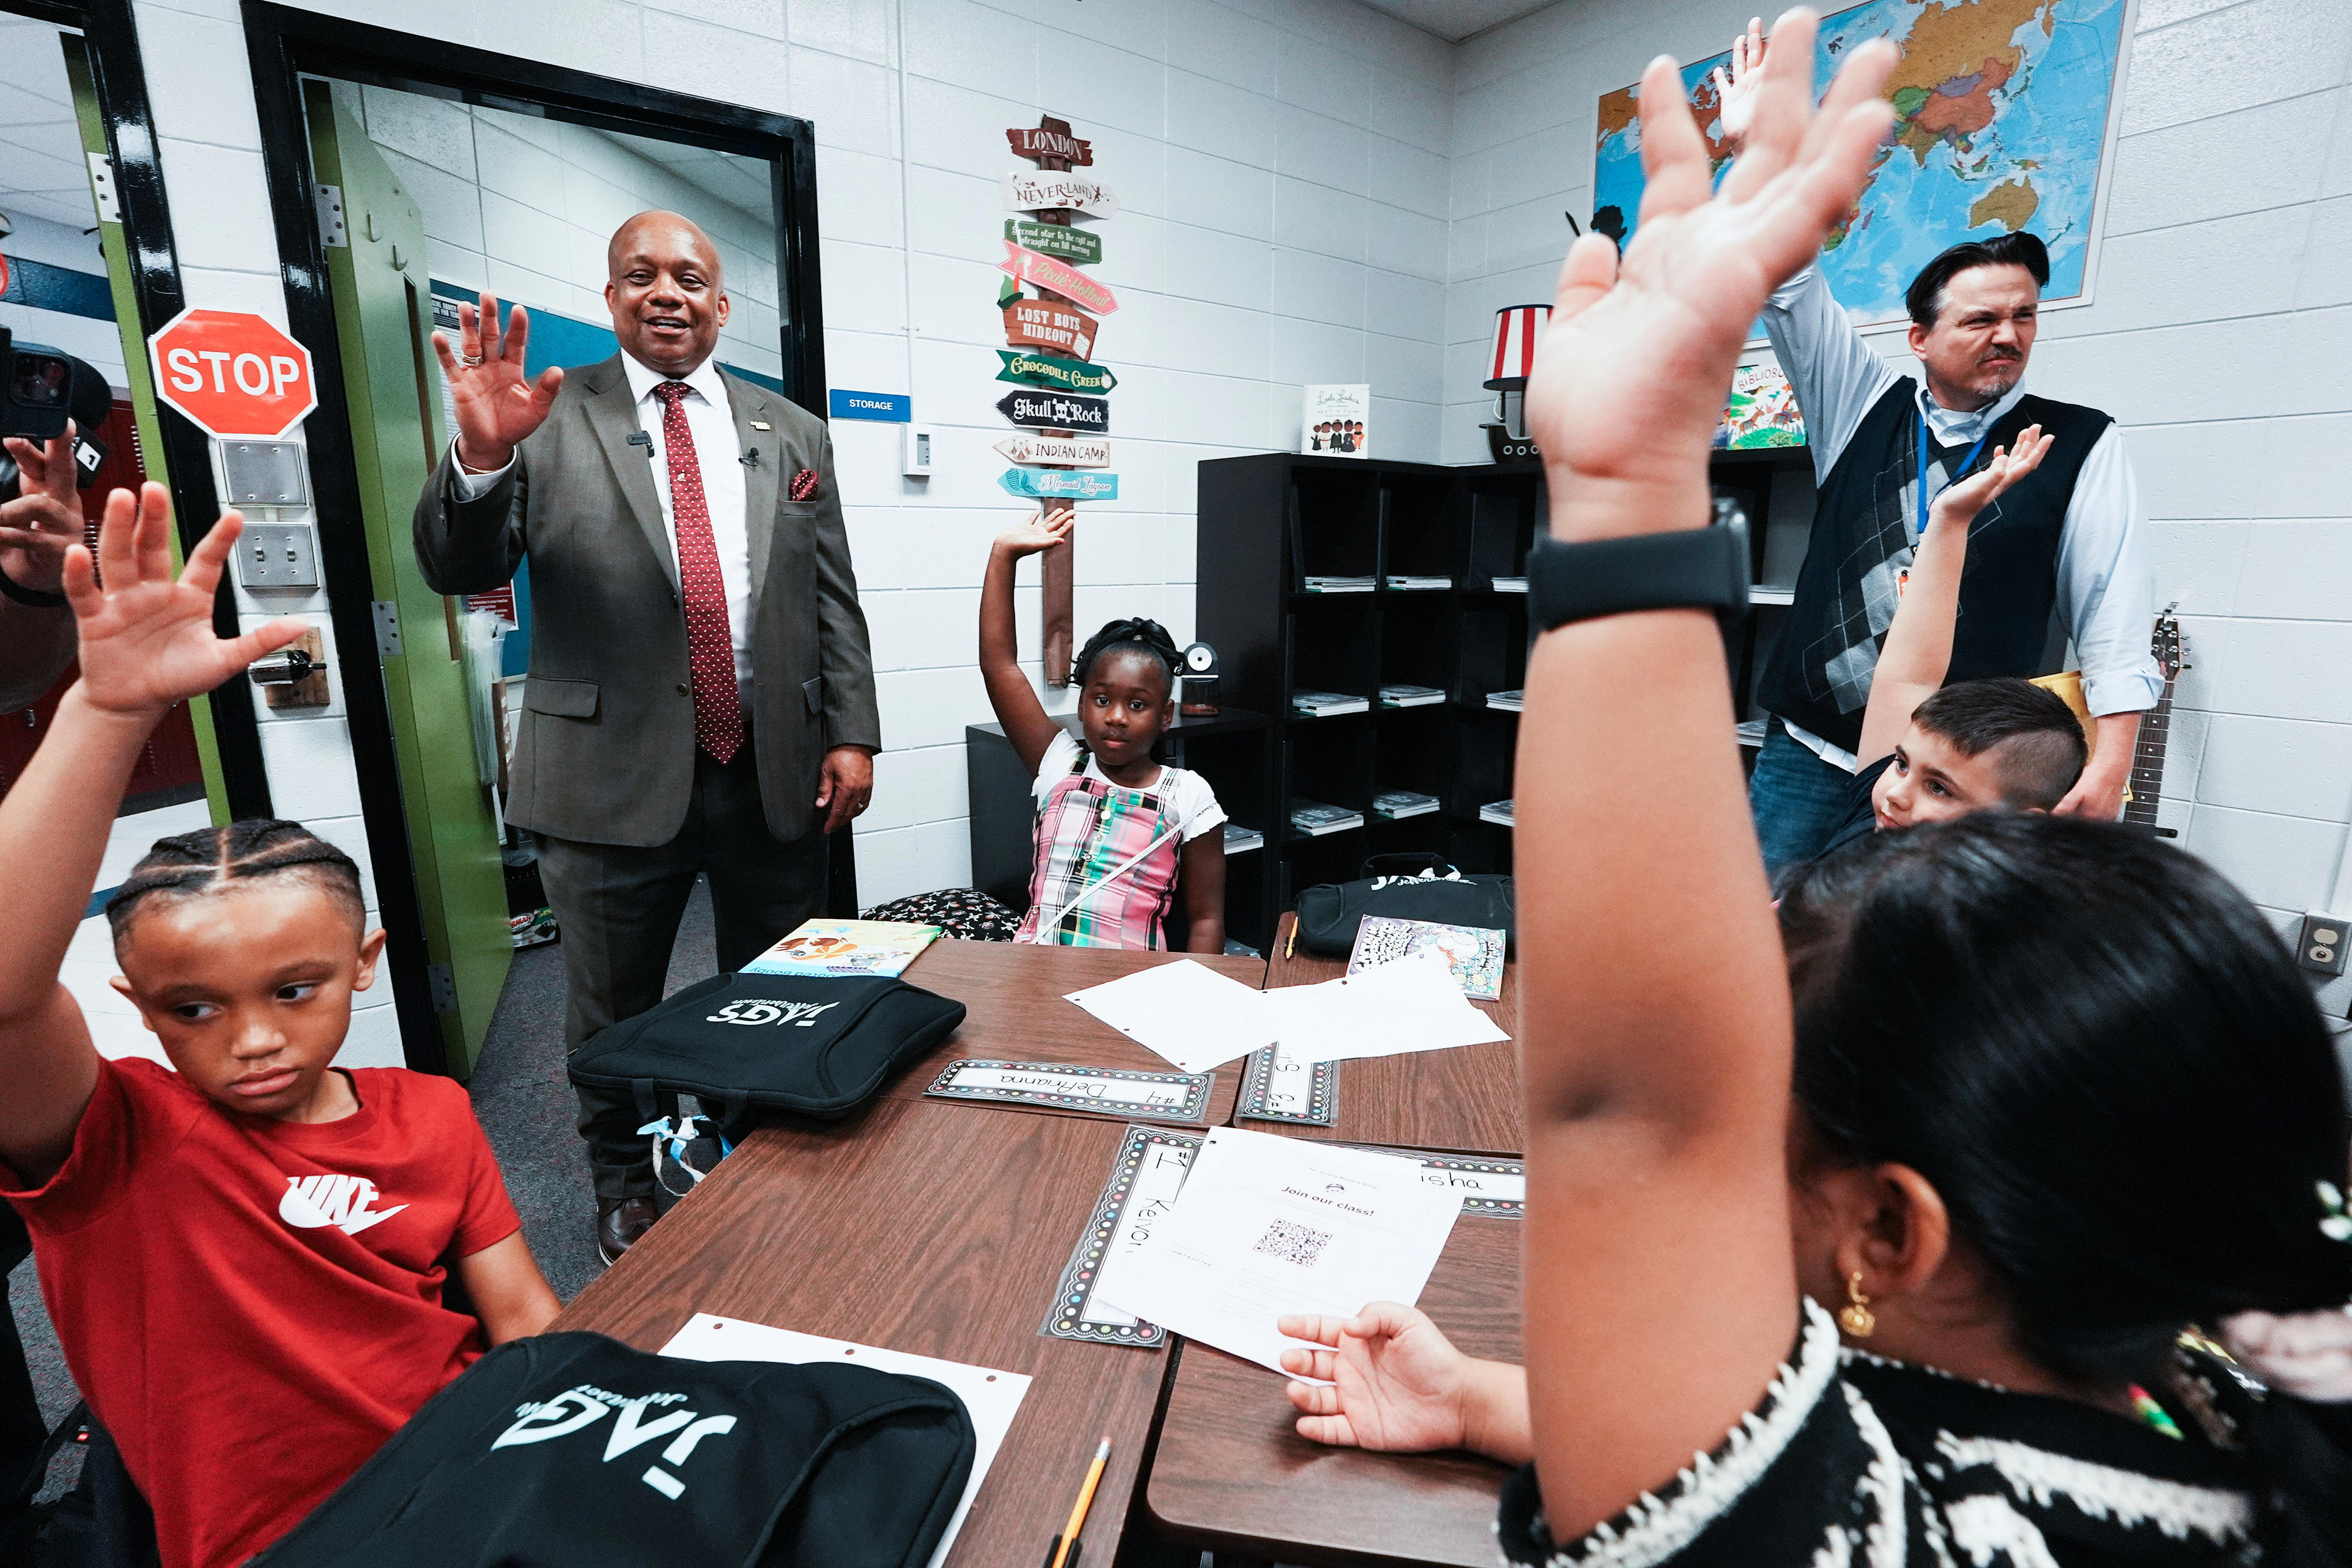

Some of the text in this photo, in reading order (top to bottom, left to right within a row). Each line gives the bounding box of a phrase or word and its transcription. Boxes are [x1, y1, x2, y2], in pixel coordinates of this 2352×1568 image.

[1023, 130, 1082, 160] LONDON
[1041, 229, 1055, 239] star
[1057, 231, 1064, 240] to
[1034, 262, 1111, 307] Pixie Hollow
[1017, 307, 1081, 331] LOST BOYS
[1023, 323, 1073, 345] HIDEOUT
[167, 347, 301, 397] STOP
[1010, 357, 1069, 381] CROCODILE
[849, 399, 893, 410] STORAGE
[1013, 398, 1103, 423] Skull Rock
[1036, 443, 1106, 462] INDIAN CAMP
[1038, 474, 1111, 495] Mermaid Lagoon
[1001, 1075, 1177, 1106] #4 DeArianna
[1269, 1093, 1295, 1107] #3
[1156, 1152, 1190, 1169] #1
[1420, 1170, 1484, 1191] isha
[287, 1174, 379, 1226] NIKE
[1282, 1186, 1308, 1198] Join
[1312, 1196, 1334, 1205] our
[1337, 1203, 1375, 1217] class!
